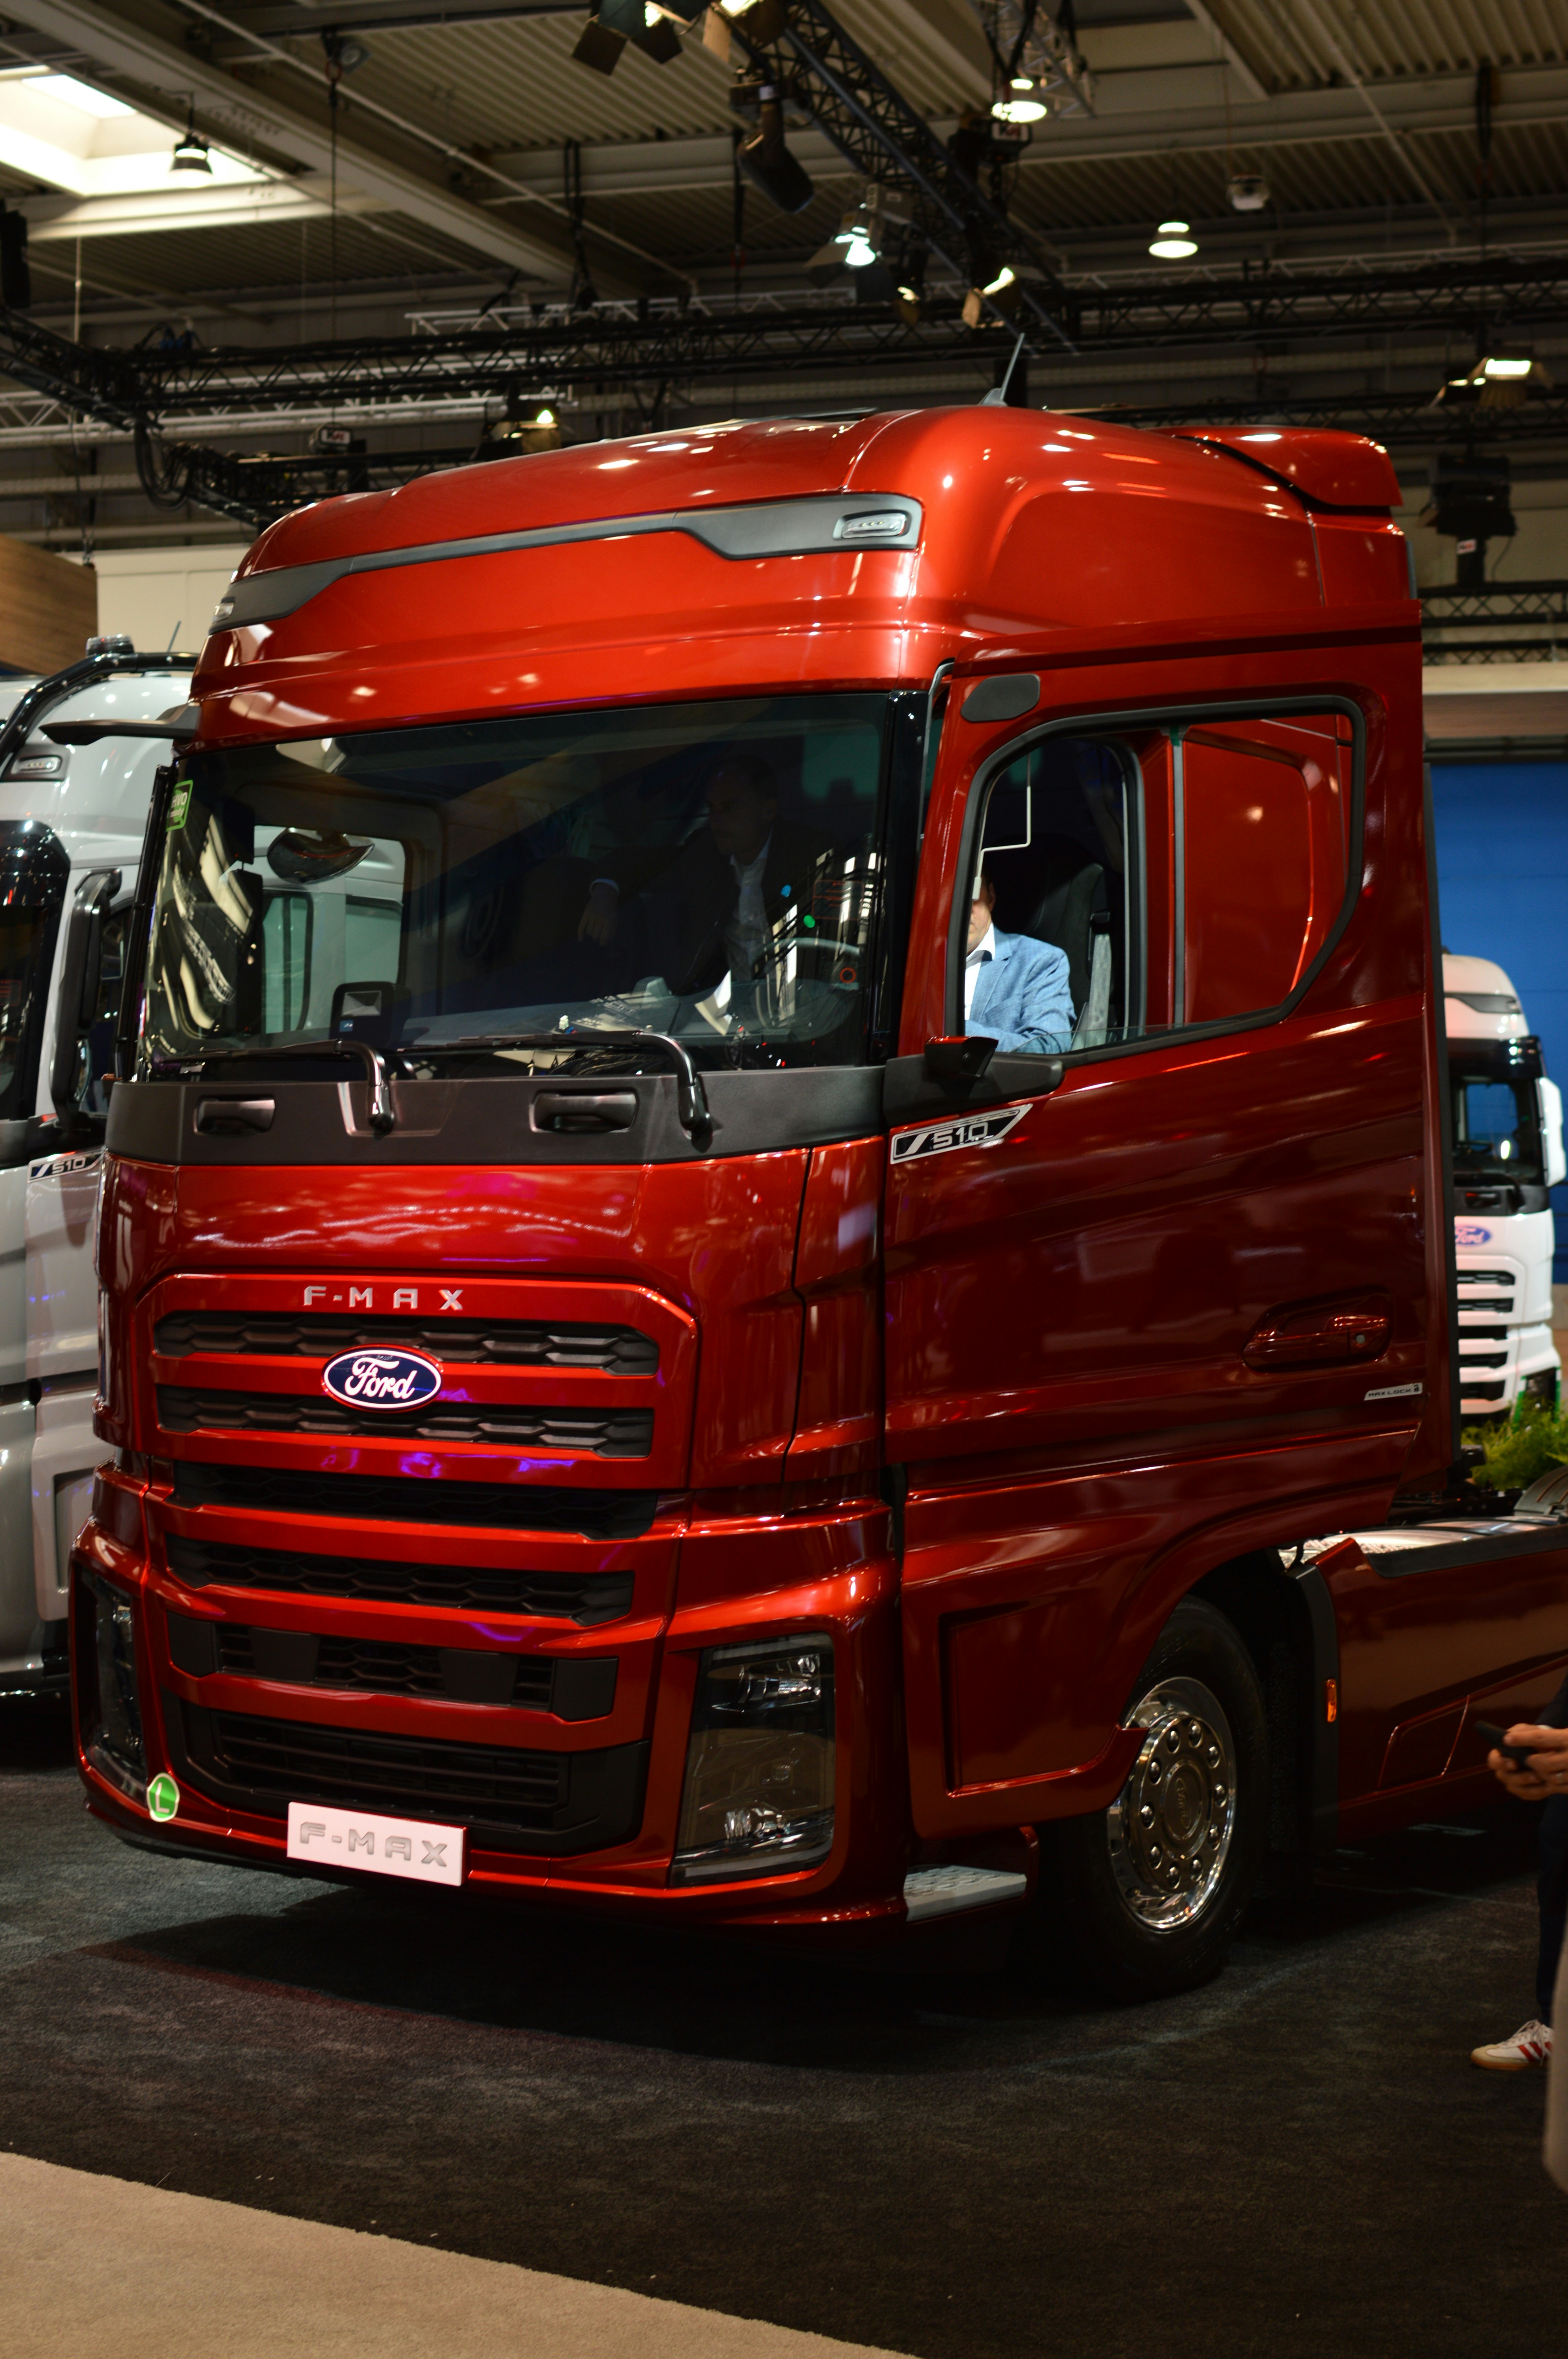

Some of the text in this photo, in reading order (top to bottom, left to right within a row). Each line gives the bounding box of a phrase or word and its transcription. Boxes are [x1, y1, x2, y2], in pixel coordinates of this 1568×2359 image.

[171, 792, 188, 808] HVO
[933, 1122, 988, 1149] 510
[51, 1158, 86, 1174] 510
[303, 1285, 464, 1310] F-MAX
[344, 1357, 417, 1399] Ford
[155, 1782, 170, 1814] L
[300, 1821, 447, 1867] F-MAX
